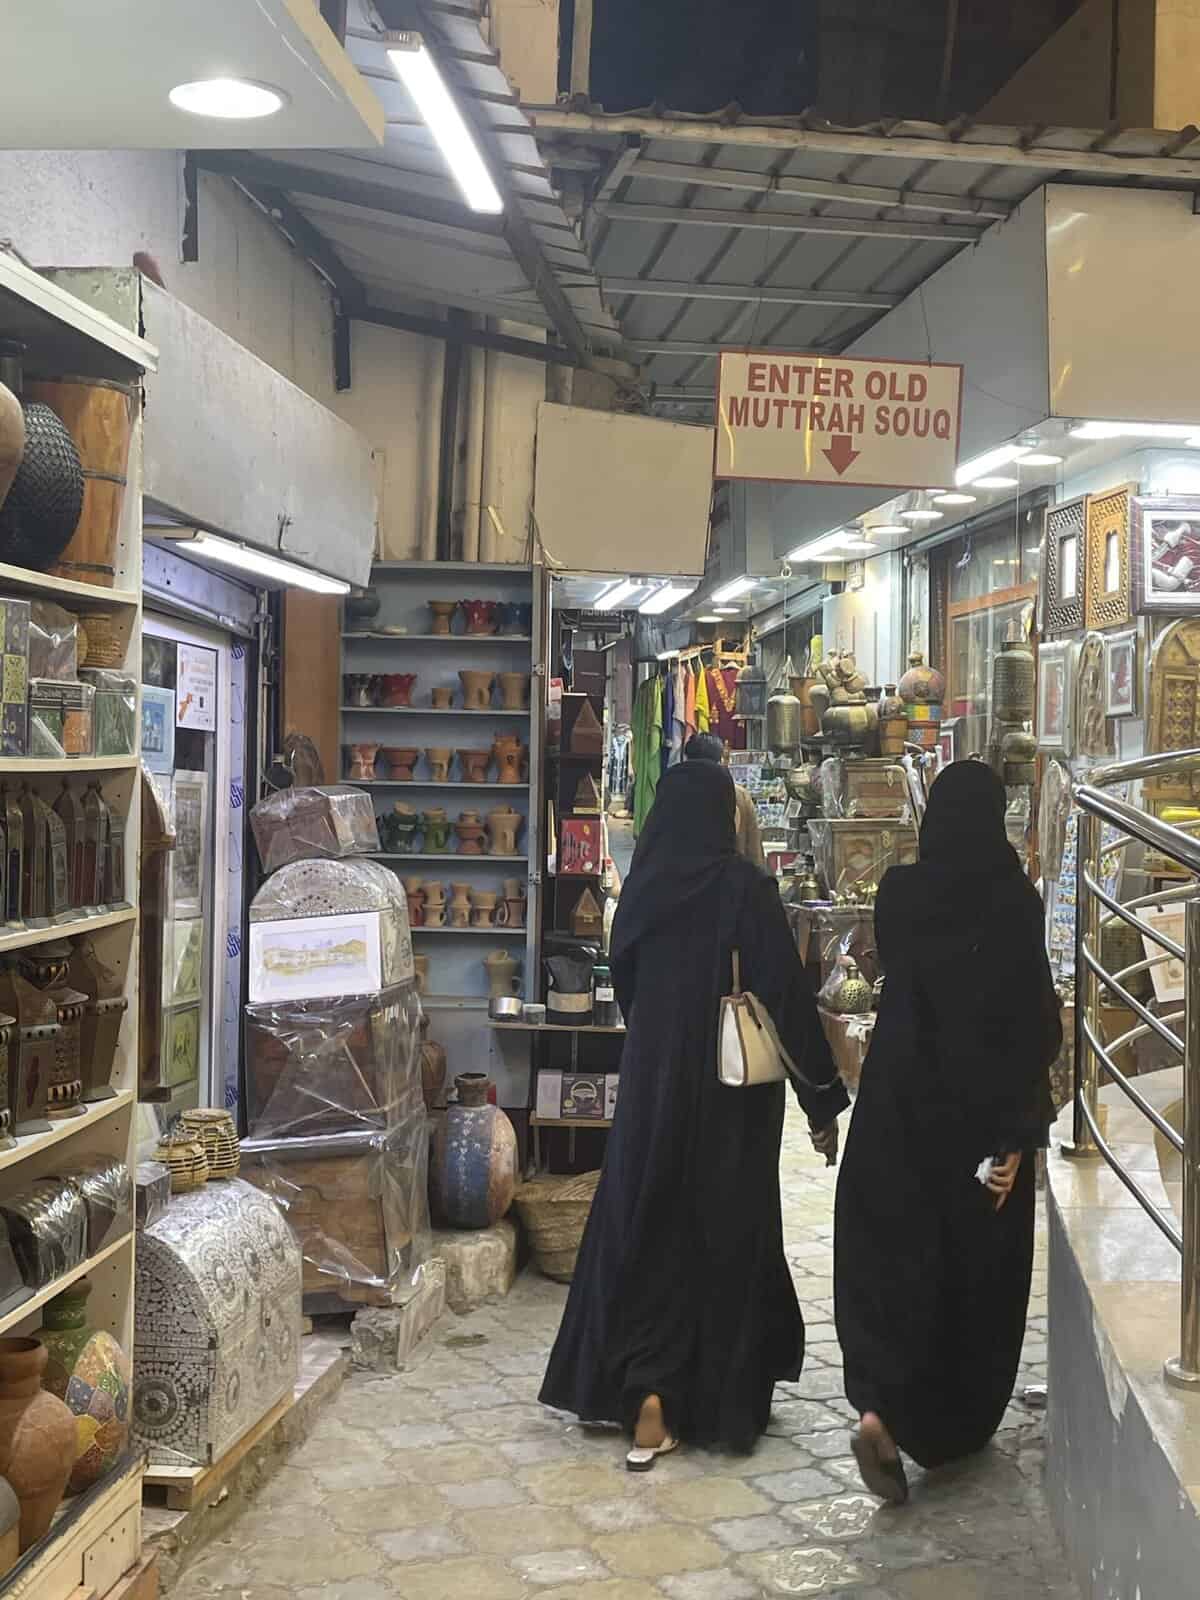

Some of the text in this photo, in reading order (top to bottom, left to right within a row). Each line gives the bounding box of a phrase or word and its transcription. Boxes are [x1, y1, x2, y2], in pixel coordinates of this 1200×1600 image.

[747, 362, 928, 402] ENTER OLD
[728, 396, 951, 440] MUTTRAH SOUQ
